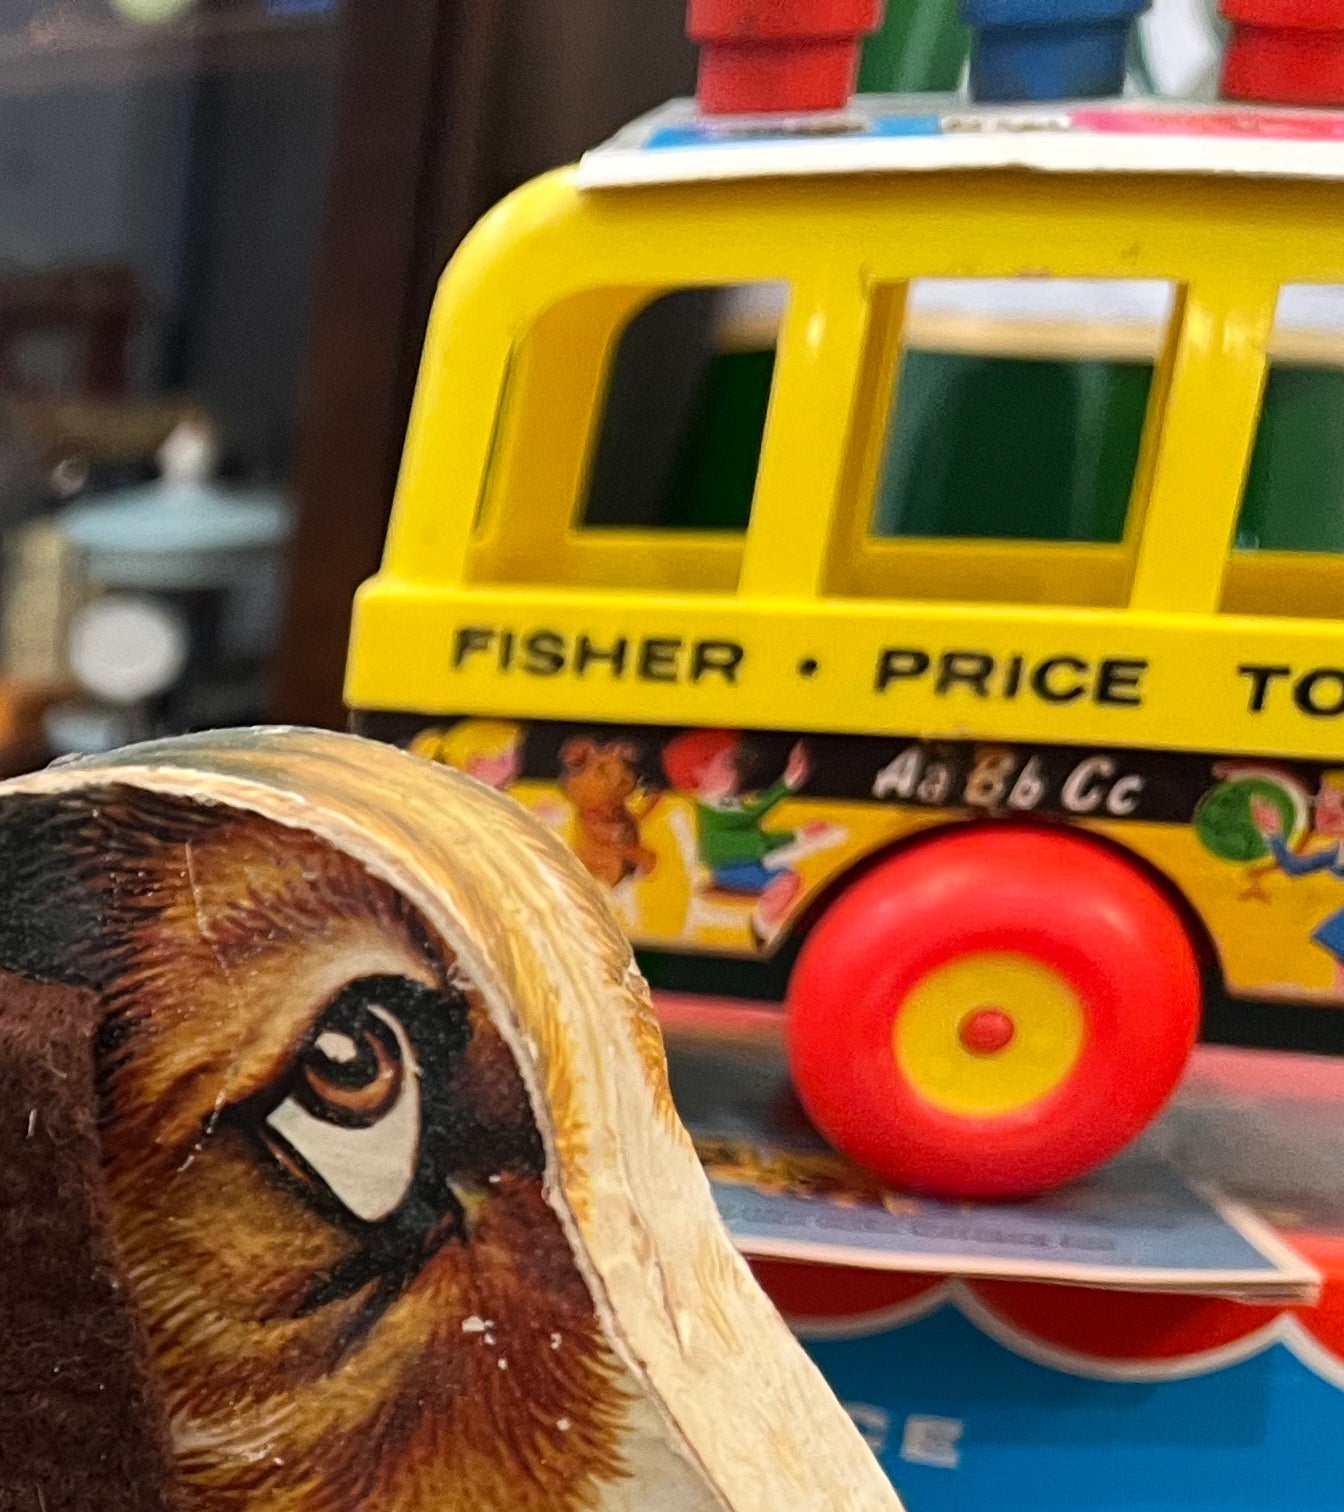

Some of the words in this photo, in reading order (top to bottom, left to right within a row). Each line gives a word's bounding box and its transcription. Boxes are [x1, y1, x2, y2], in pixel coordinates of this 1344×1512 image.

[451, 625, 745, 682] FISHER
[873, 648, 1150, 707] PRICE
[1237, 665, 1344, 718] TO
[1061, 755, 1144, 816] Cc
